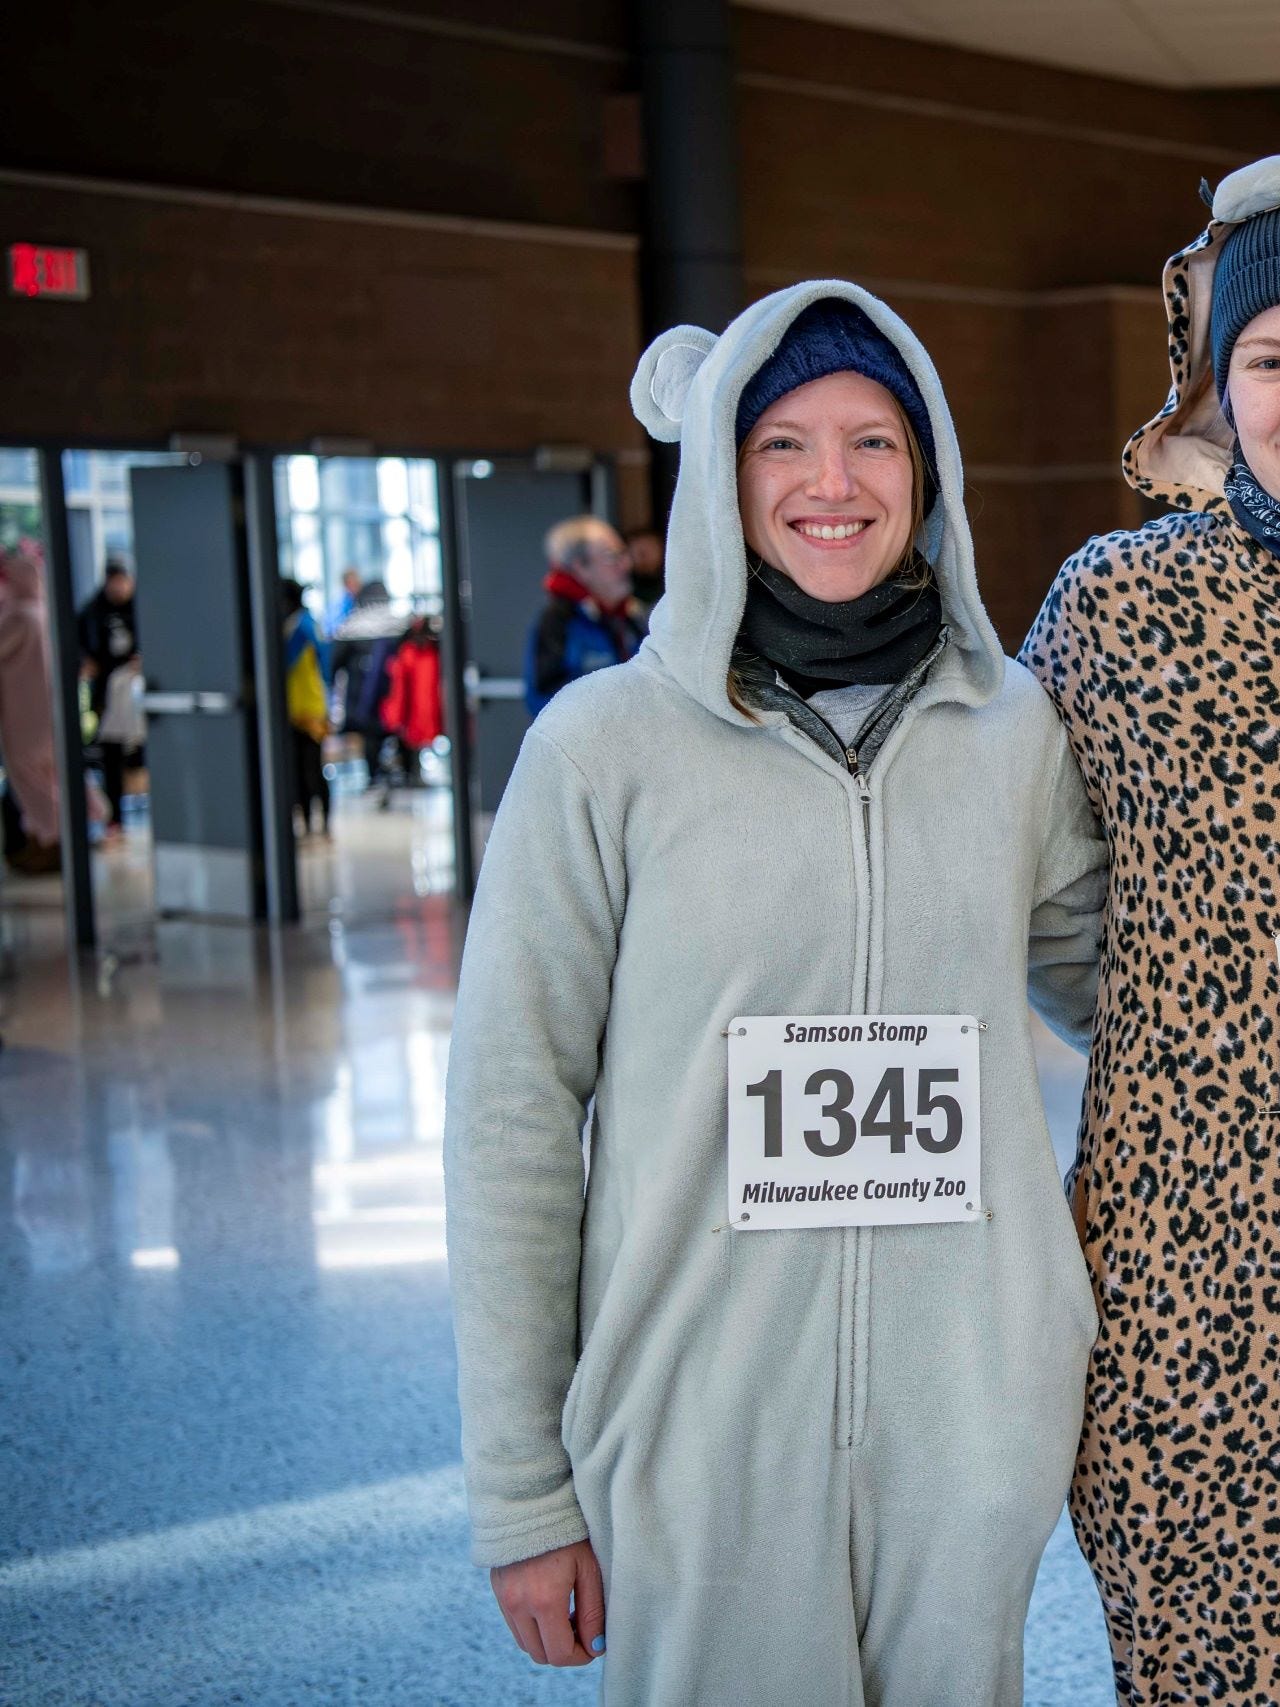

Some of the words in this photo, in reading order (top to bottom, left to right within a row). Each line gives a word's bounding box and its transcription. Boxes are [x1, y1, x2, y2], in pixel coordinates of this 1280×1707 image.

[783, 1022, 863, 1043] Samson
[867, 1021, 928, 1046] Stomp
[746, 1067, 963, 1158] 1345
[742, 1179, 859, 1204] Milwaukee
[863, 1177, 931, 1202] County
[933, 1176, 967, 1197] Zoo
